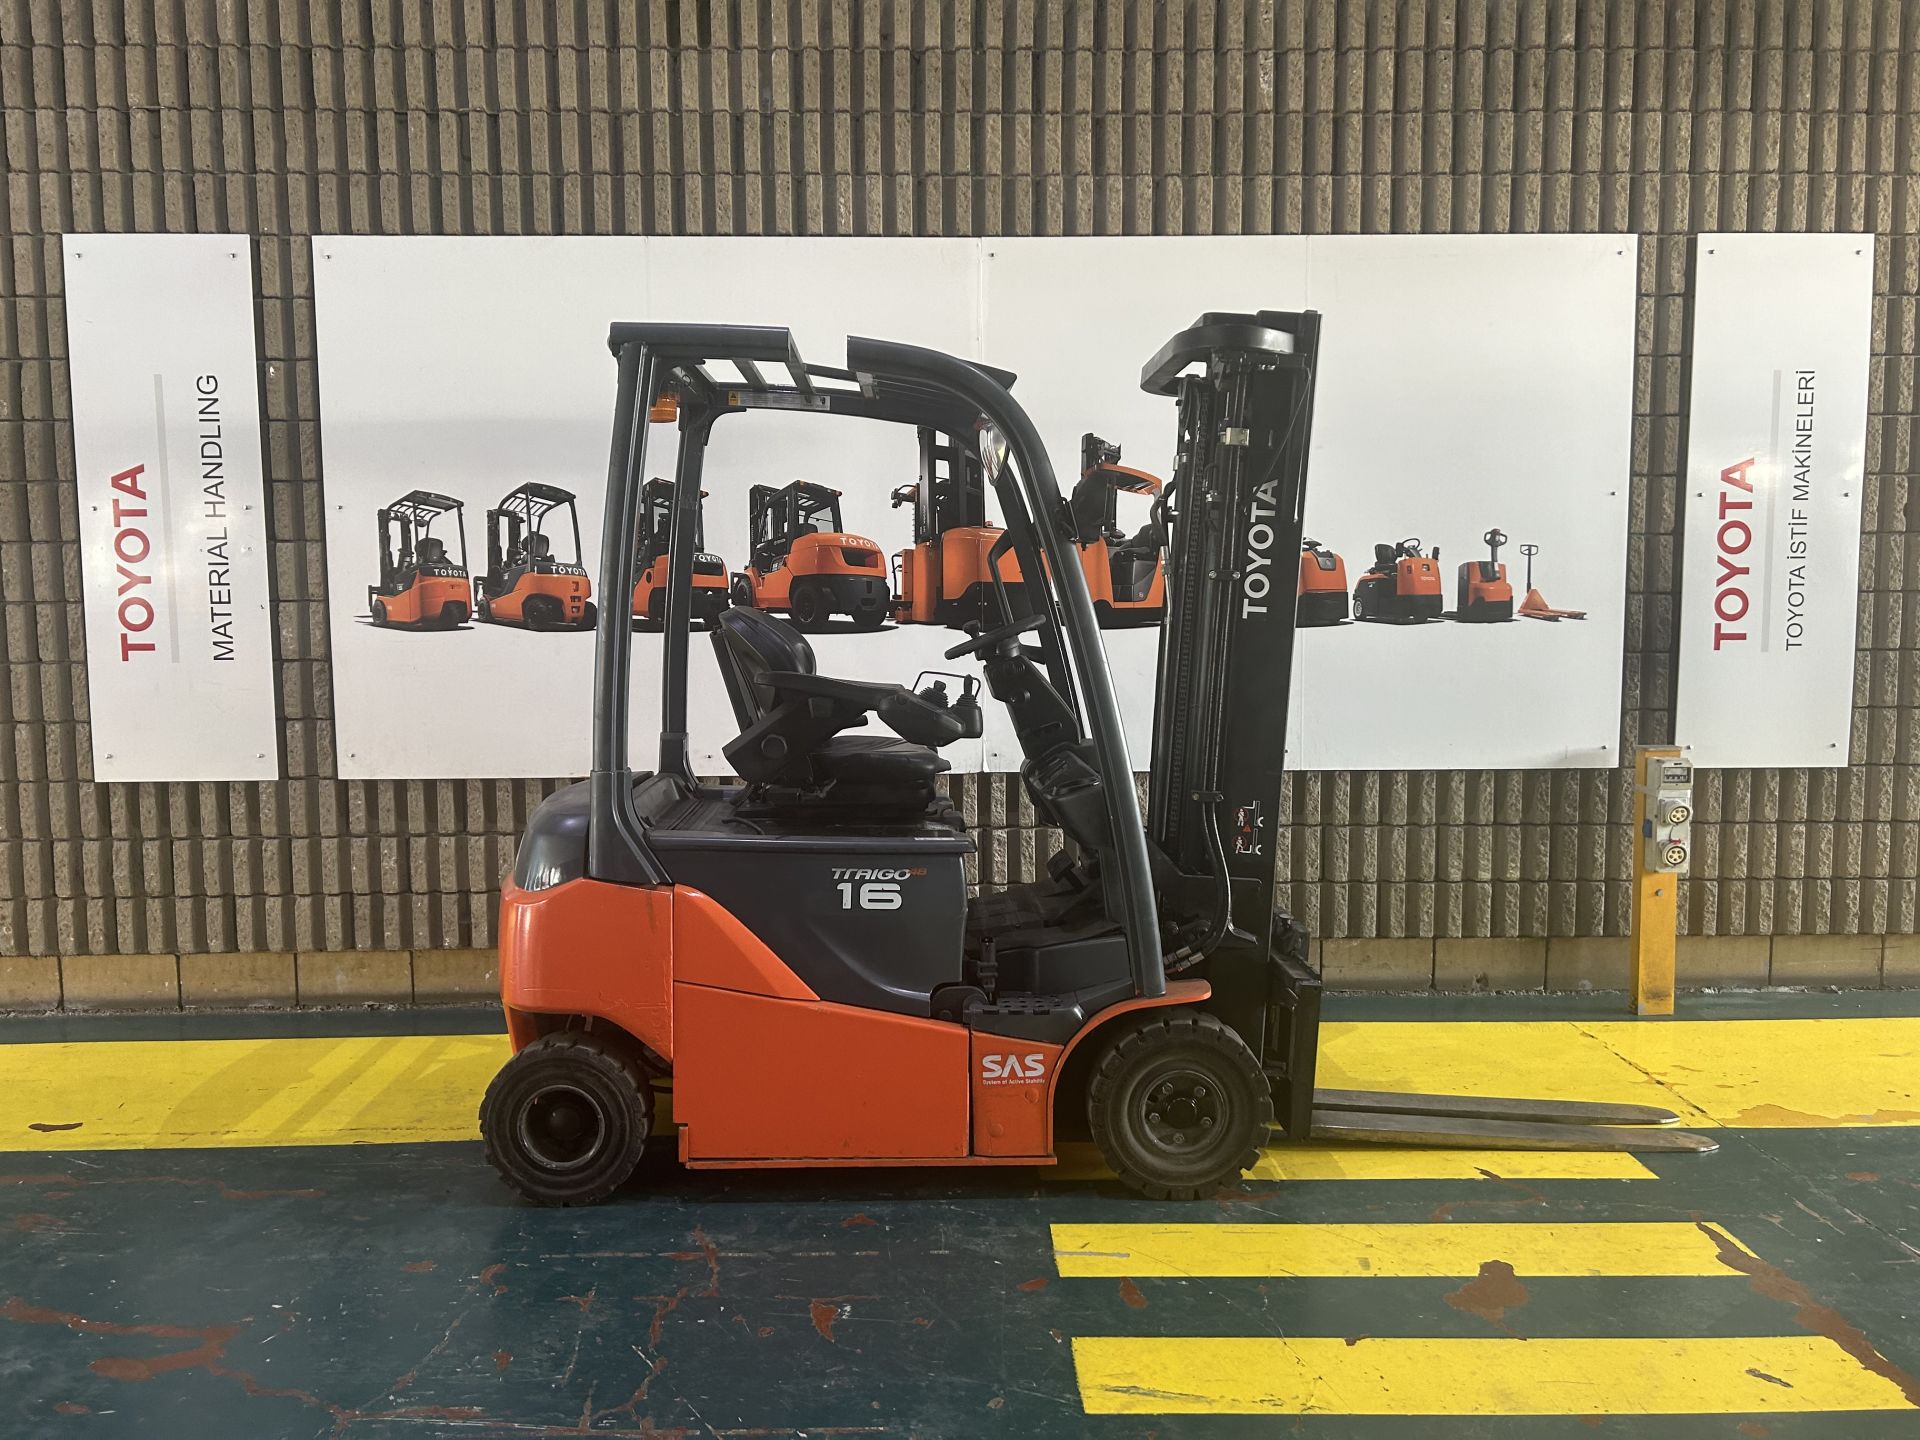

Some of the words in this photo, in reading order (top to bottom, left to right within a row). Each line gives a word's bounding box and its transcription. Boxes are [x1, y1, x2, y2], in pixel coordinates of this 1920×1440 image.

[196, 374, 227, 518] HANDLING
[111, 463, 156, 662] TOYOTA
[206, 526, 235, 661] MATERIAL
[433, 568, 467, 577] TOYOTA
[551, 566, 586, 576] TOYOTA
[1241, 478, 1278, 619] TOYOTA
[1713, 457, 1755, 651] TOYOTA
[1785, 565, 1806, 652] TOYOTA
[837, 882, 902, 910] 16
[983, 1054, 1045, 1078] SAS
